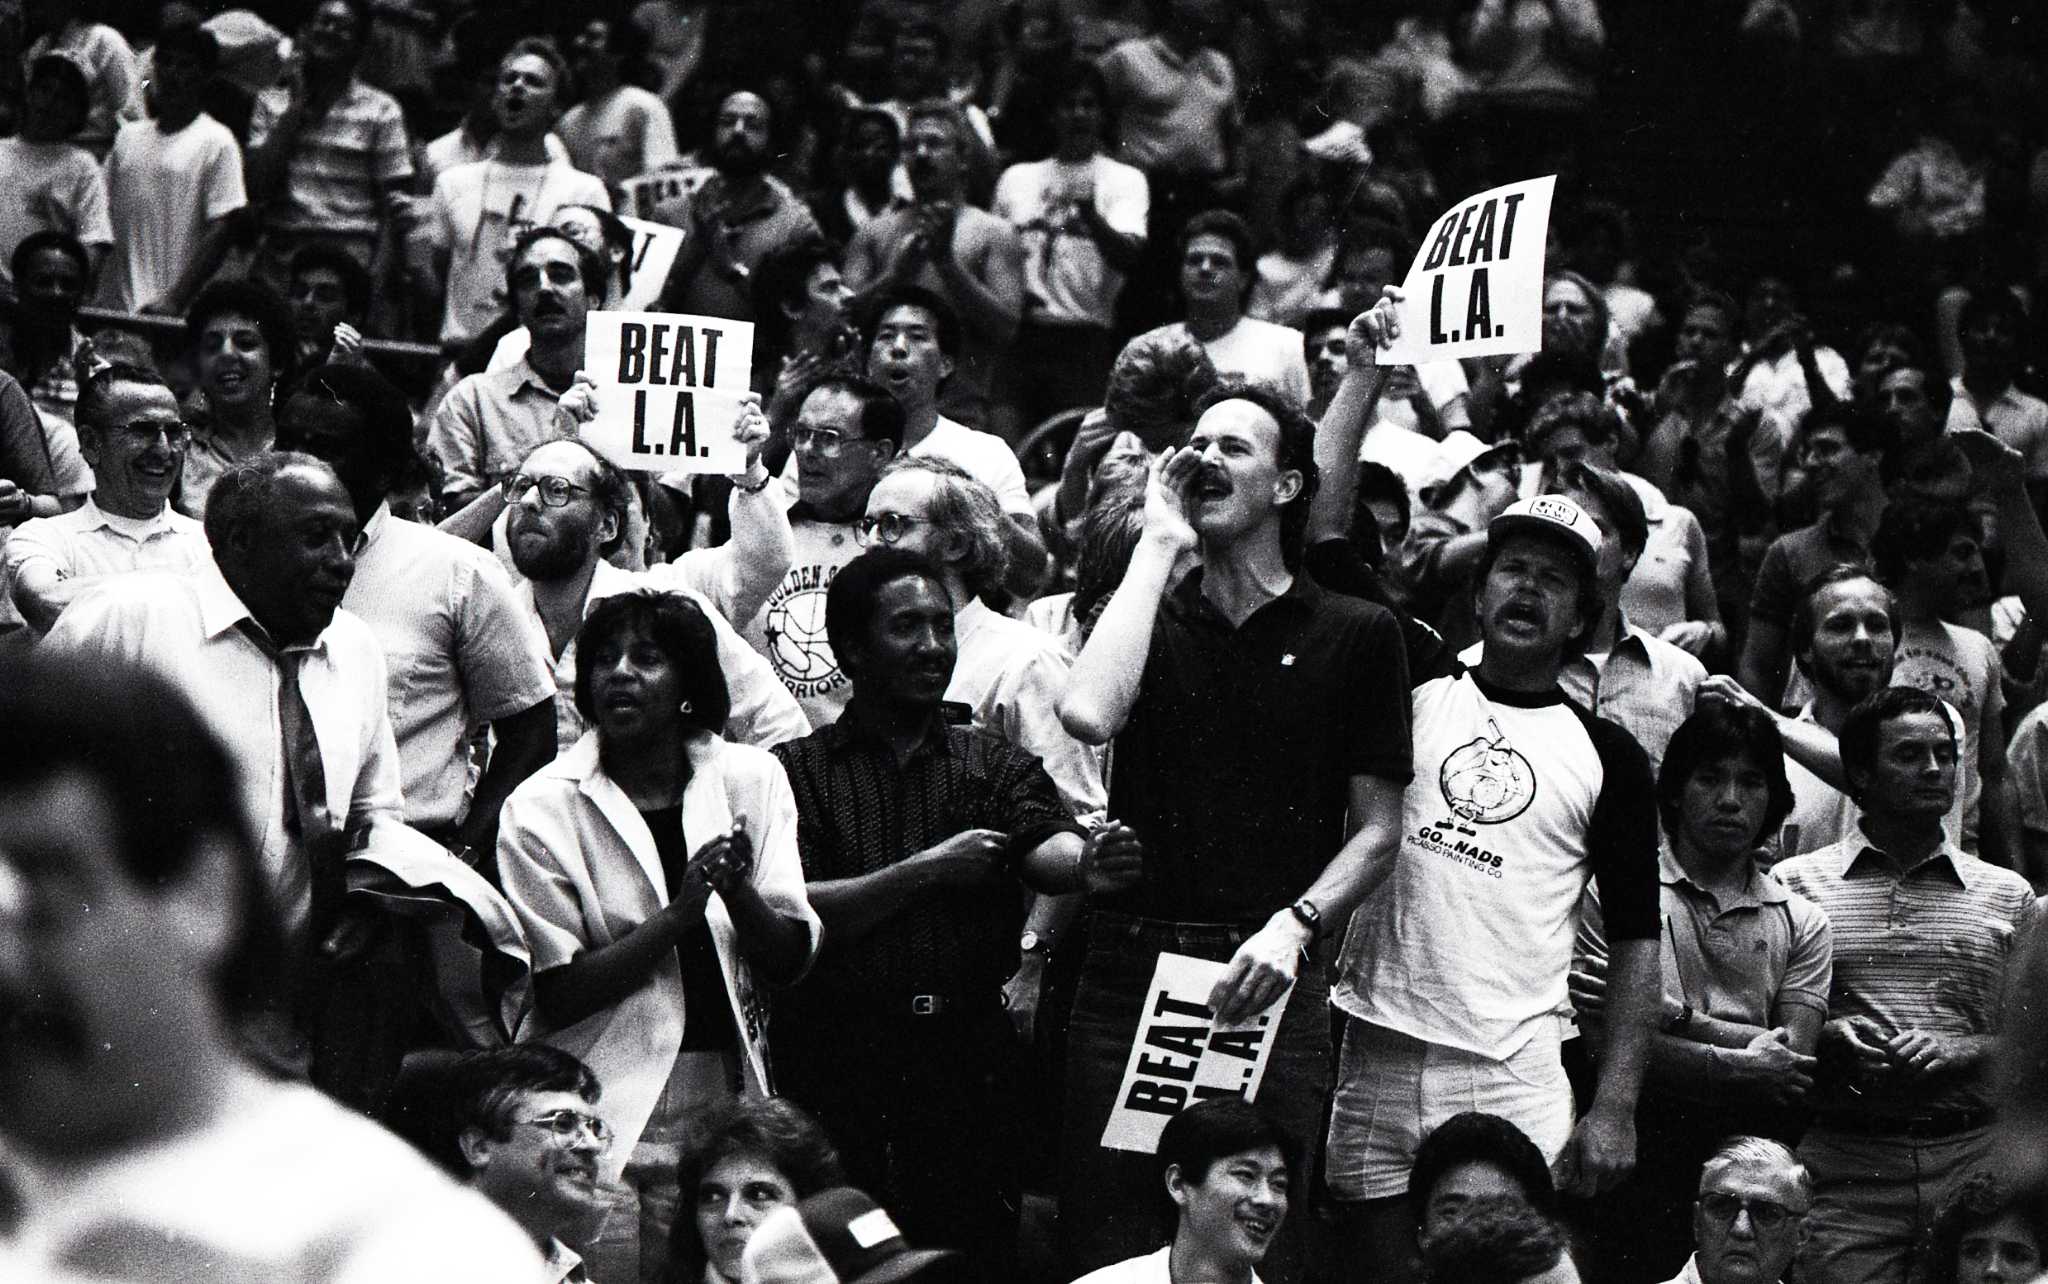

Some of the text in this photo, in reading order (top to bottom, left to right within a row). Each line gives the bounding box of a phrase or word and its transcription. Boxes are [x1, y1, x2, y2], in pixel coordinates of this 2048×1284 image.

[1422, 193, 1524, 272] BEAT
[1430, 267, 1504, 345] L.A.
[618, 322, 723, 389] BEAT
[632, 389, 709, 457] L.A.
[1419, 826, 1503, 868] GO...NADS
[1442, 849, 1485, 872] PAINTING
[1124, 990, 1214, 1117] BEAT
[1192, 1015, 1269, 1101] L.A.
